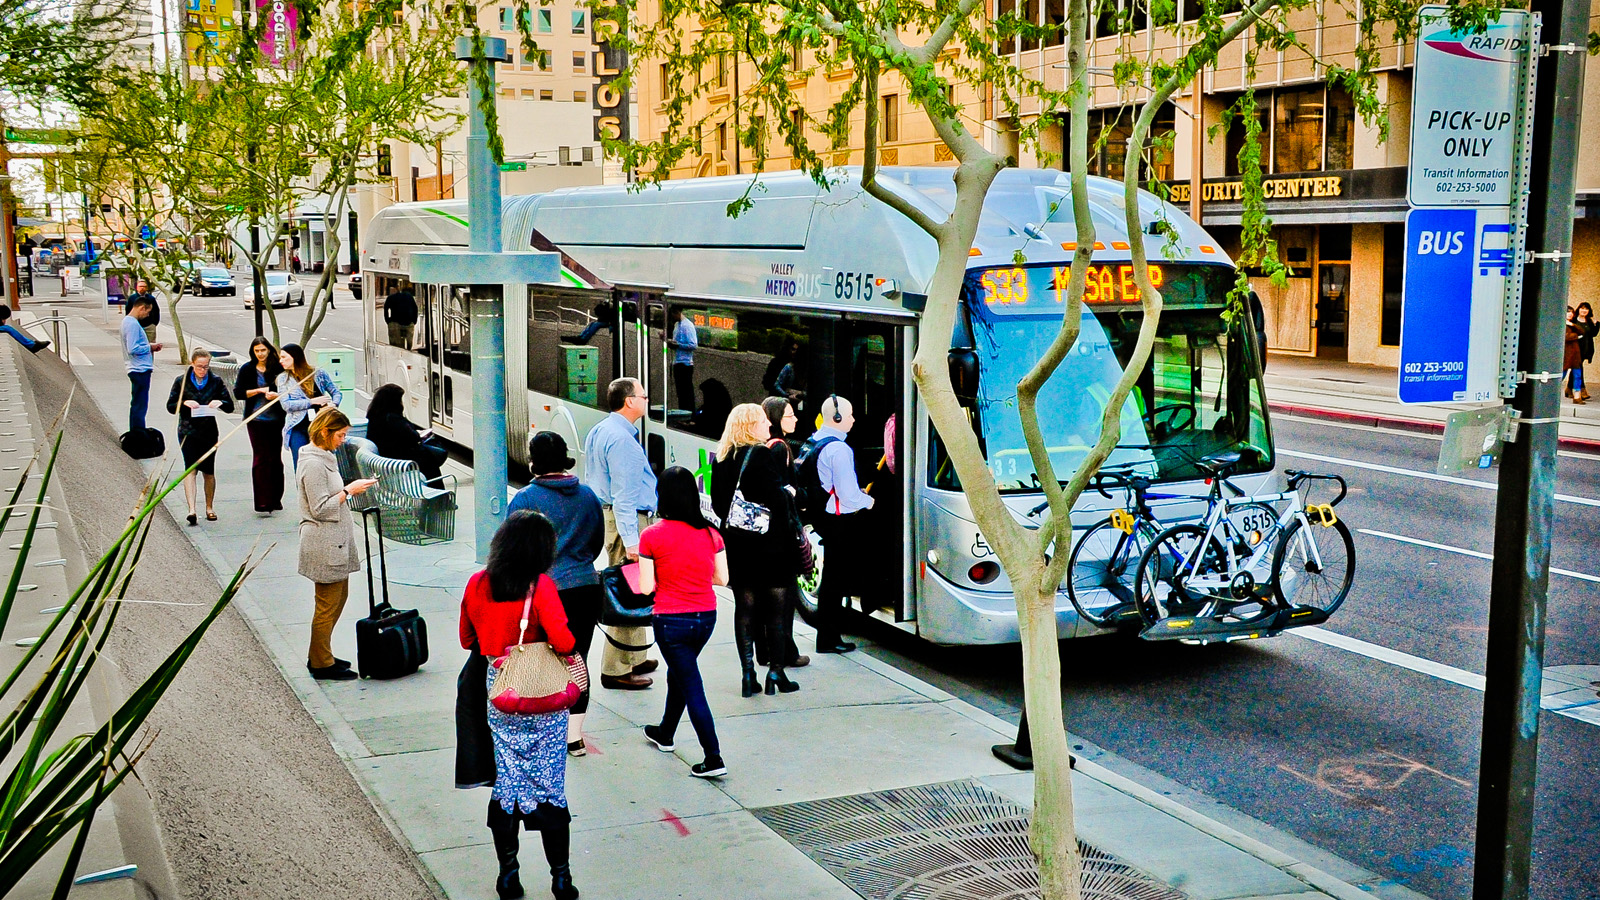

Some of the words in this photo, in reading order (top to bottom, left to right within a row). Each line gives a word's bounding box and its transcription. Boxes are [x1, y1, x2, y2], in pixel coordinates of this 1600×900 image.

[1469, 36, 1522, 51] RAPID
[1428, 110, 1511, 131] PICK-UP
[1443, 137, 1493, 157] ONLY
[1423, 168, 1454, 178] Transit
[1456, 168, 1510, 179] Information
[1170, 181, 1250, 202] SEURIT
[1263, 176, 1342, 198] CENTER
[1436, 182, 1497, 193] 602-253-5000
[1417, 231, 1465, 255] BUS
[770, 263, 795, 275] VALLEY
[834, 271, 874, 301] 8515
[980, 266, 1028, 304] 533
[1054, 264, 1114, 302] MSA
[1119, 264, 1163, 302] EP
[1404, 363, 1422, 373] 602
[1423, 361, 1464, 373] 253-5000
[1404, 374, 1425, 382] transit
[1426, 372, 1464, 382] information
[1475, 391, 1490, 400] 12-14
[1242, 510, 1271, 533] 8515
